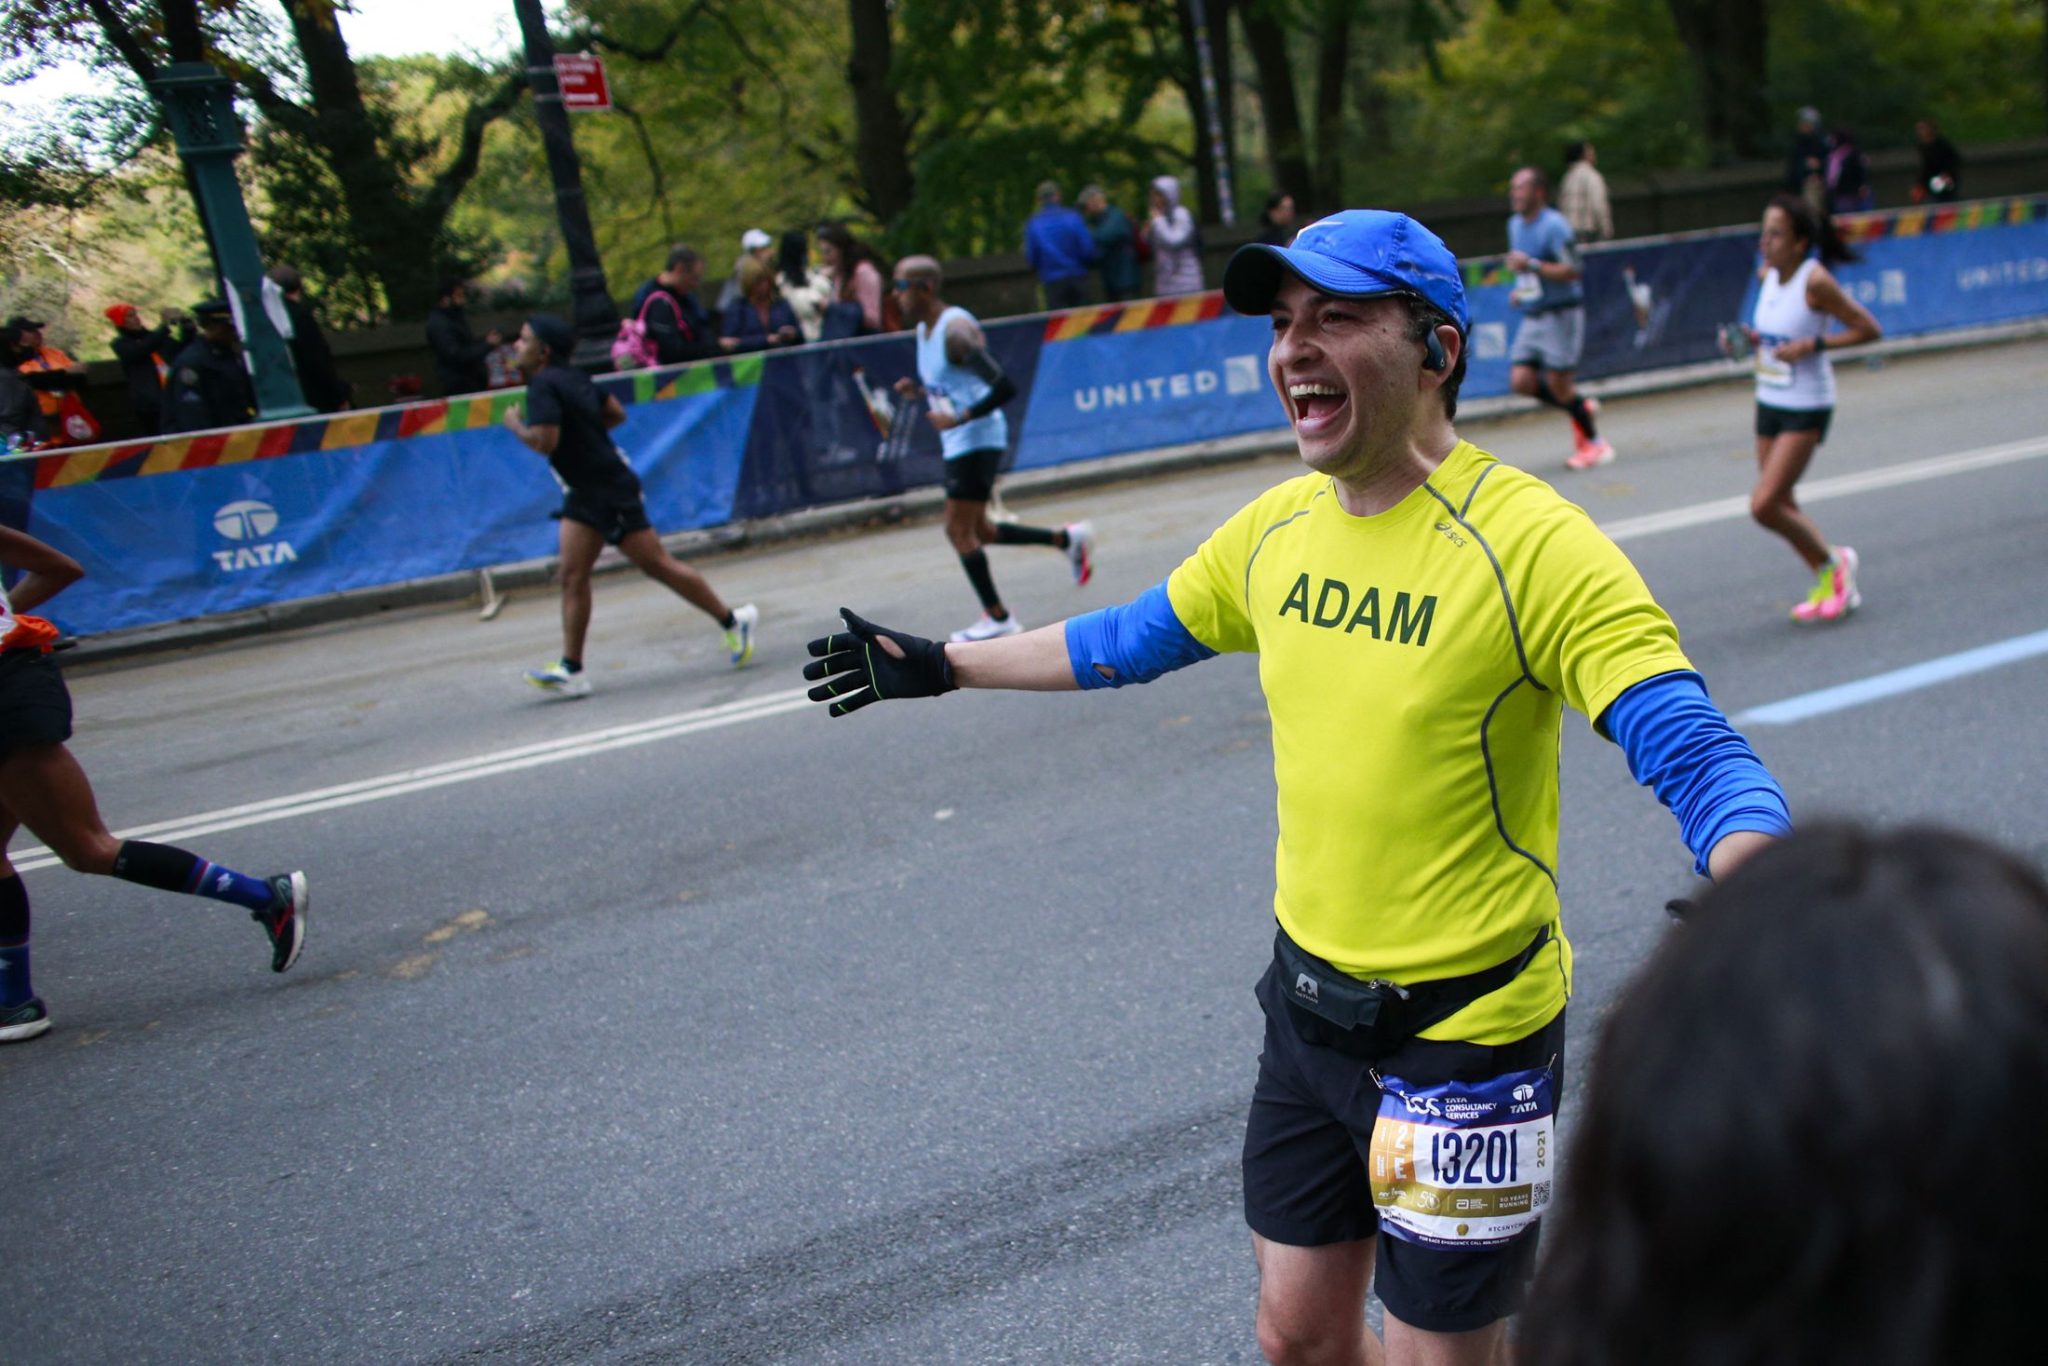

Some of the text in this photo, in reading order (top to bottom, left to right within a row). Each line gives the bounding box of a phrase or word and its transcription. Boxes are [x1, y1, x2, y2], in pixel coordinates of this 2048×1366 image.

[1074, 370, 1218, 412] UNITED
[211, 541, 298, 571] TATA
[1278, 572, 1438, 647] ADAM
[1445, 1102, 1498, 1112] CONSULTANCY
[1445, 1111, 1480, 1119] SERVICES
[1509, 1101, 1538, 1114] TATA
[1394, 1123, 1408, 1150] 2
[1536, 1130, 1546, 1168] 2021
[1431, 1128, 1517, 1184] 13201
